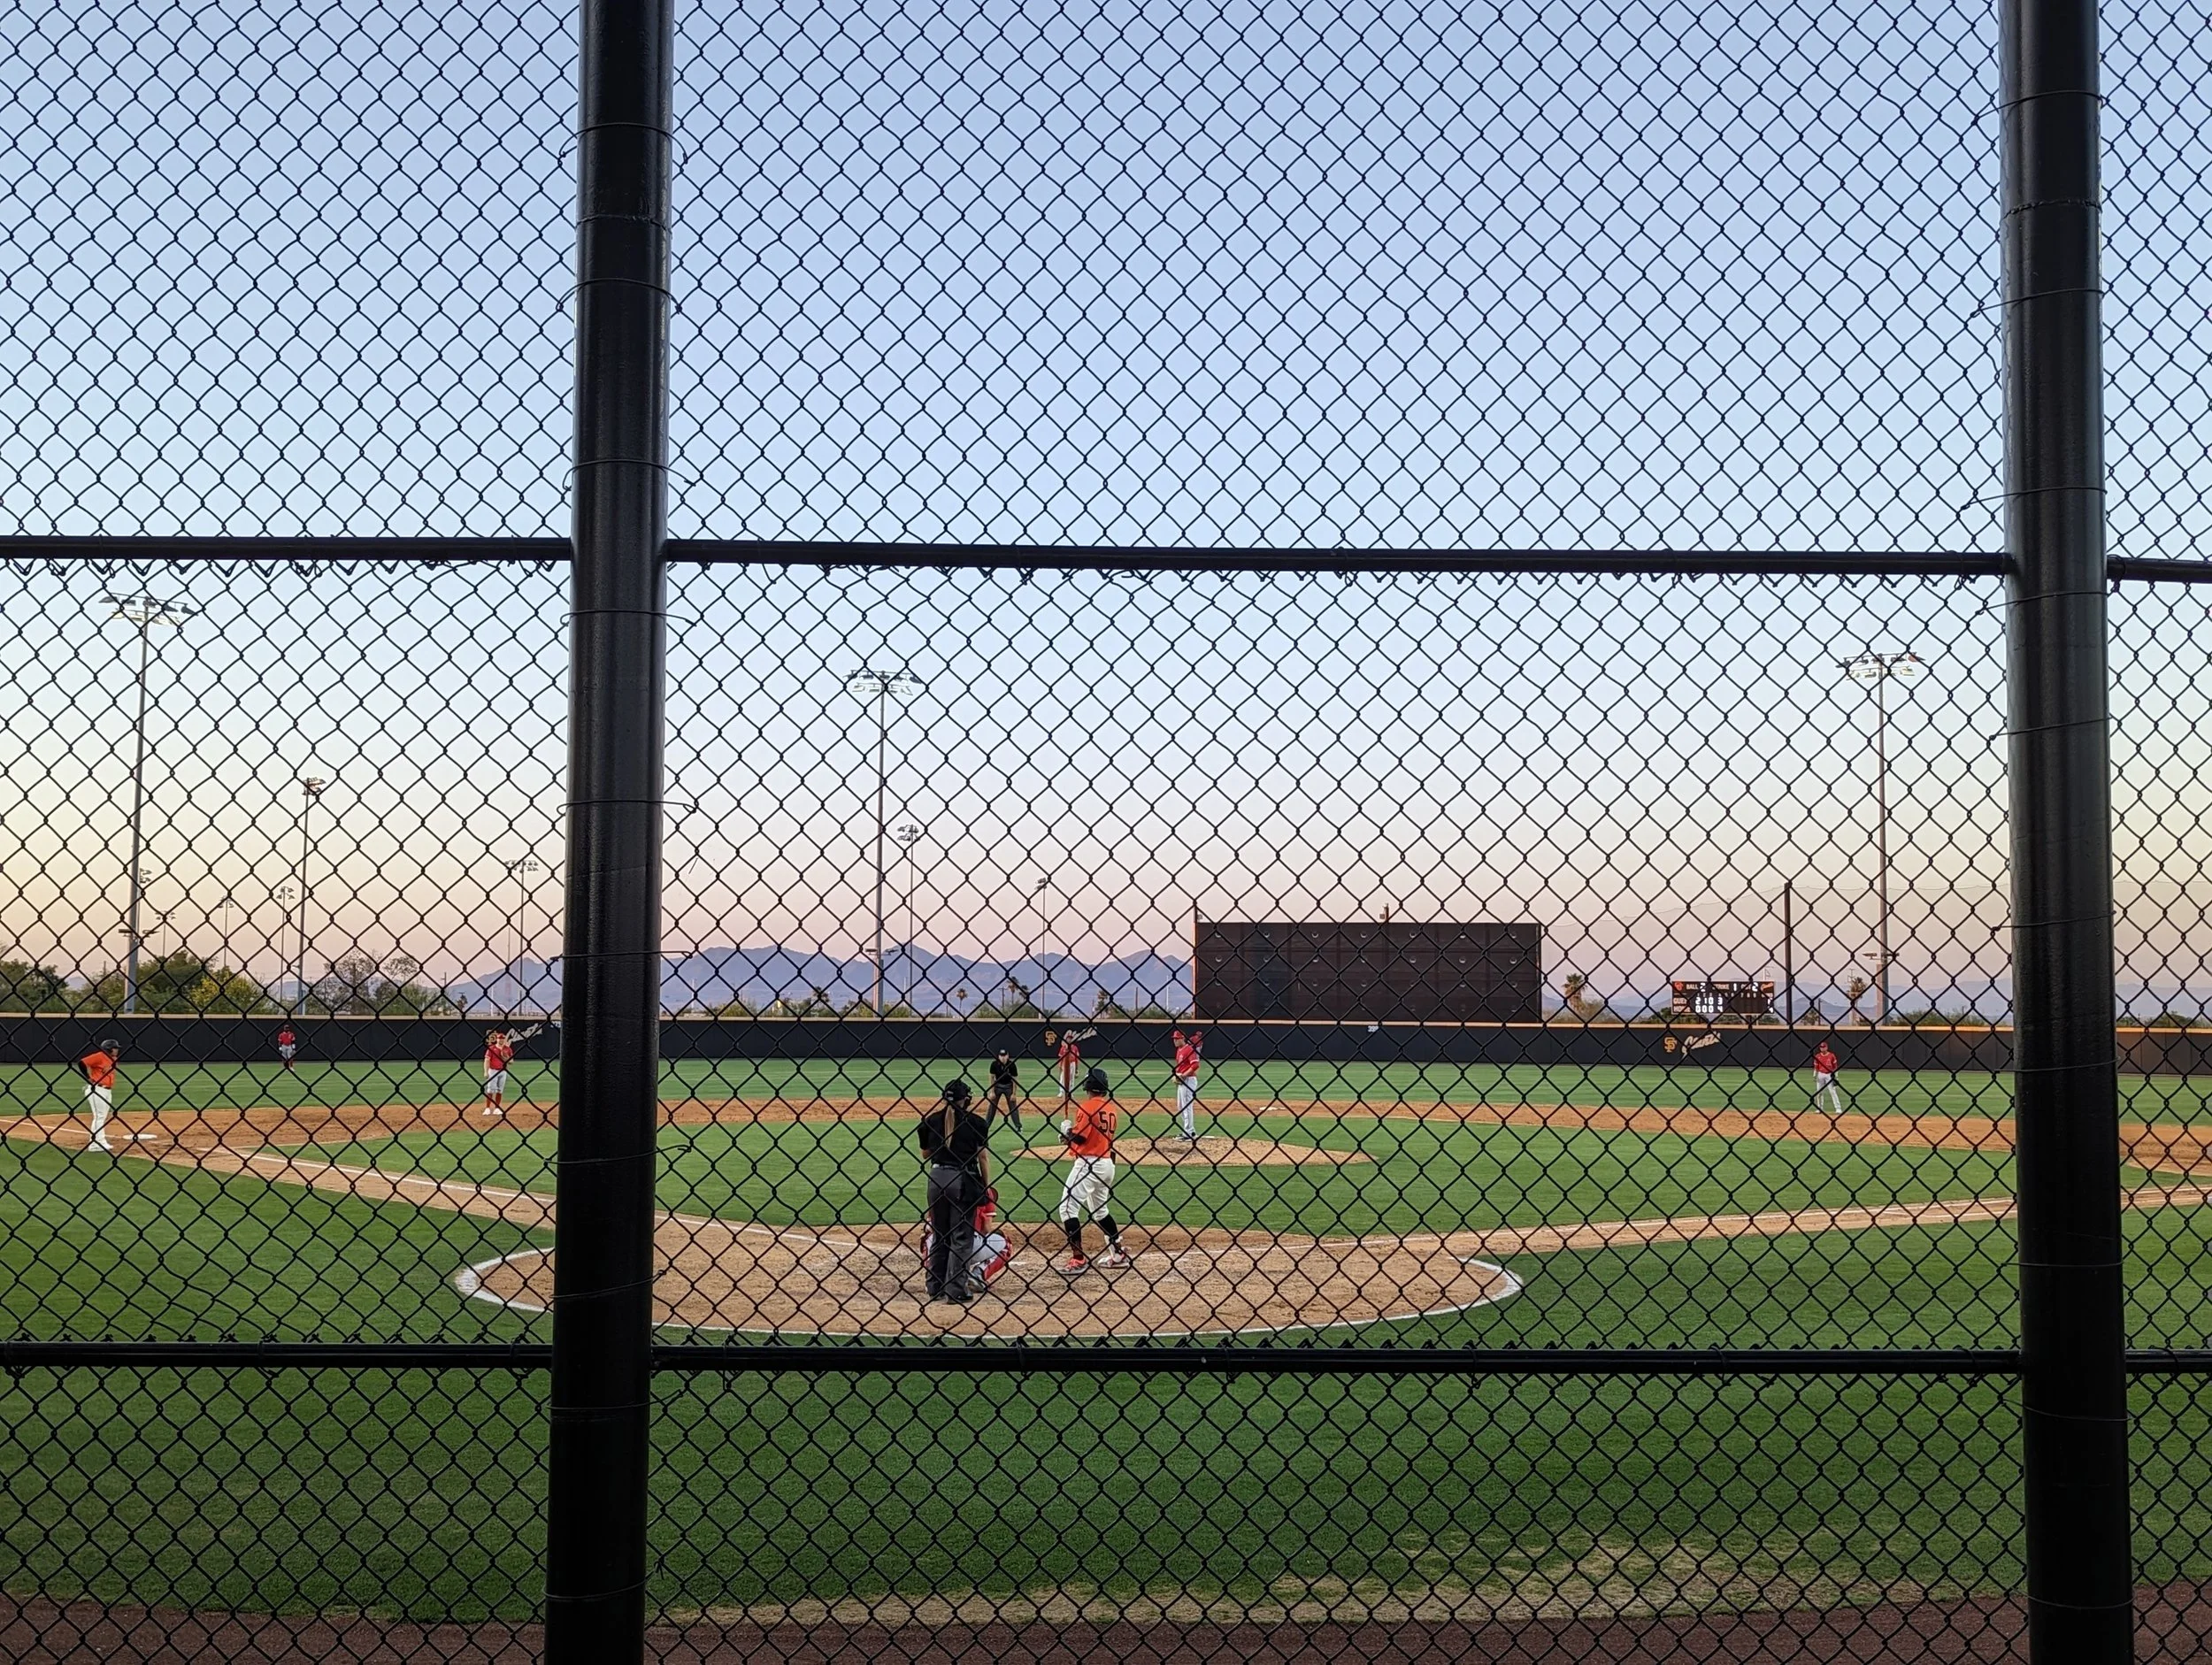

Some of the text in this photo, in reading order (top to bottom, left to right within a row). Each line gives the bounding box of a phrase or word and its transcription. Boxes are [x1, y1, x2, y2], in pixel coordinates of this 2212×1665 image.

[1700, 982, 1706, 992] 2
[1733, 983, 1738, 992] 1
[1752, 982, 1759, 992] 2
[1098, 1110, 1118, 1134] 50
